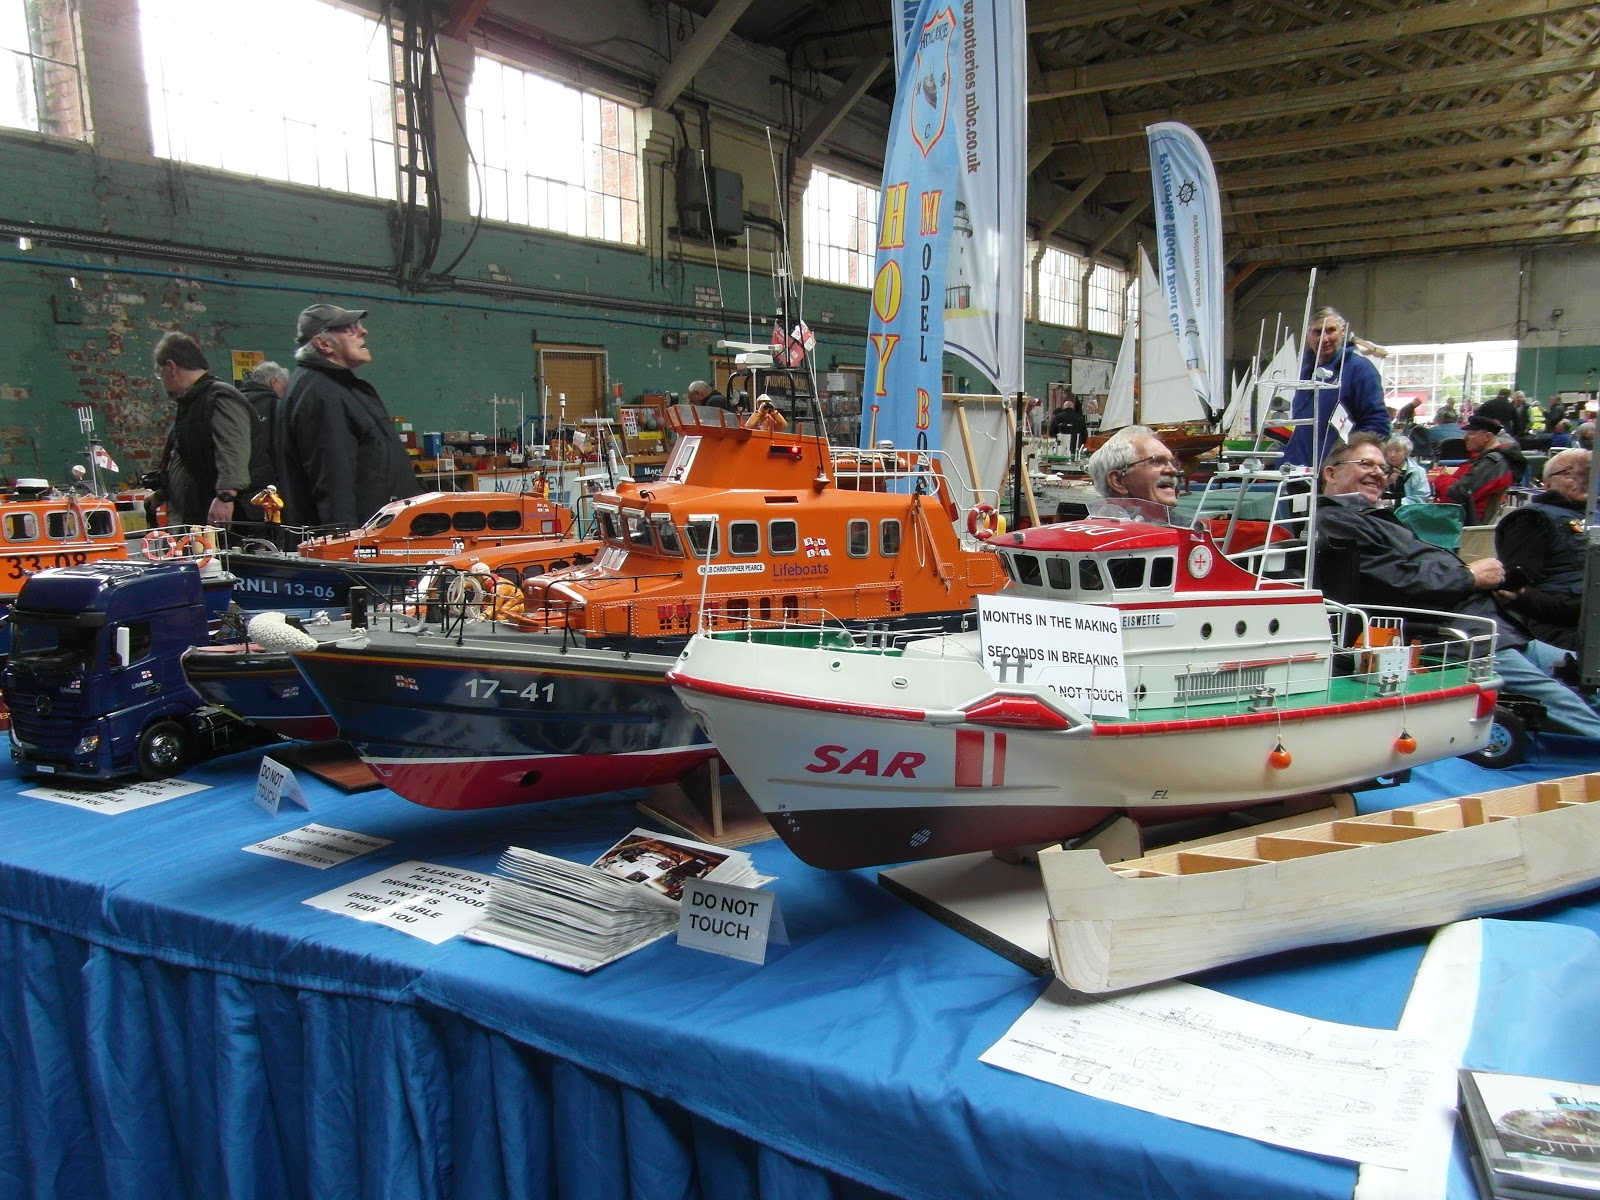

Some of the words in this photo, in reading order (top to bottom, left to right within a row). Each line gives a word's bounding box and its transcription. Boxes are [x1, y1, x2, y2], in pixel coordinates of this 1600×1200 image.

[745, 564, 763, 572] PEARCE
[772, 562, 829, 577] Lifeboats
[233, 577, 278, 594] RNLI
[284, 582, 335, 598] 13-06
[982, 610, 1032, 625] MONTHS
[1035, 614, 1047, 626] IN
[1050, 616, 1072, 628] THE
[1075, 618, 1118, 634] MAKING
[1122, 614, 1161, 627] EISWETTE
[987, 645, 1044, 660] SECONDS
[1048, 649, 1059, 662] IN
[1062, 651, 1119, 667] BREAKING
[465, 678, 555, 703] 17-41
[1059, 685, 1082, 699] NOT
[1085, 688, 1123, 703] TOUCH
[804, 744, 926, 779] SAR
[261, 764, 271, 780] DO
[270, 769, 284, 787] NOT
[257, 783, 277, 806] TOUCH
[1151, 790, 1168, 800] EL
[253, 843, 281, 853] PLEASE
[409, 874, 449, 886] PLACE
[450, 883, 485, 896] CUPS
[415, 866, 462, 879] PLEASE
[462, 875, 481, 884] DO
[381, 878, 429, 891] DRINKS
[429, 888, 448, 896] OR
[447, 893, 486, 908] FOOD
[388, 890, 410, 899] ON
[410, 894, 441, 905] TIS
[344, 901, 381, 913] THAN
[389, 912, 419, 924] YOU
[347, 891, 400, 906] DISPLAY
[404, 904, 443, 919] ABLE
[692, 891, 717, 910] DO
[720, 897, 759, 918] NOT
[689, 914, 750, 940] TOUCH
